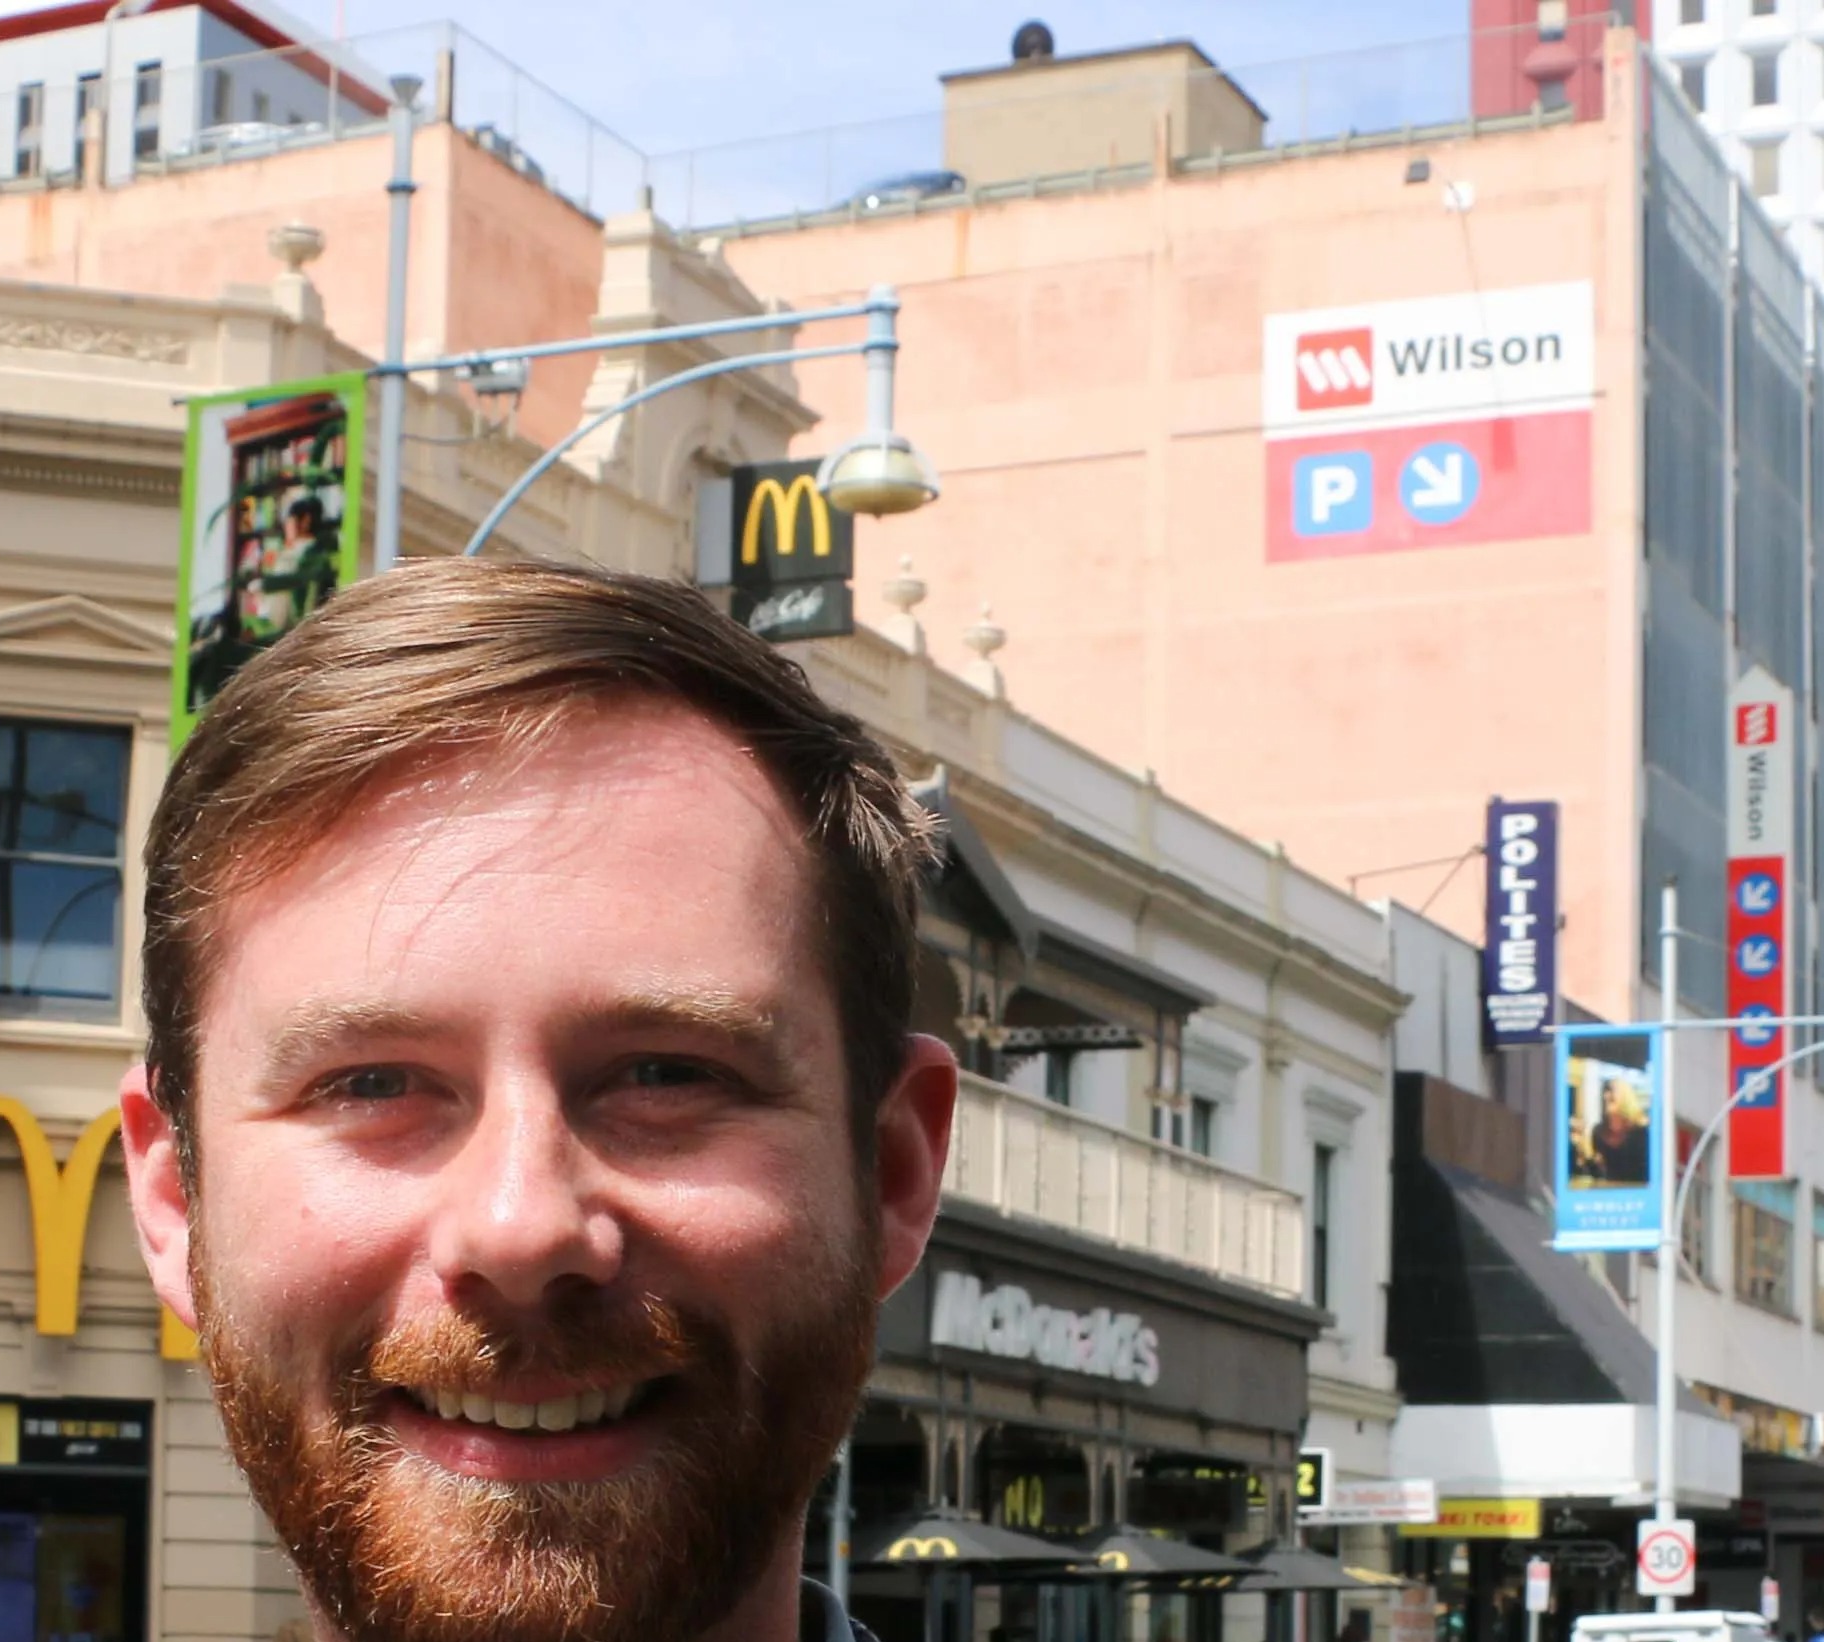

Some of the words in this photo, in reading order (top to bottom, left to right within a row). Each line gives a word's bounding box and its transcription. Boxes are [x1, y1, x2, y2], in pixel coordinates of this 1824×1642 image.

[1388, 331, 1562, 378] Wilson
[1311, 465, 1358, 524] P
[1746, 750, 1768, 842] Wilson
[1499, 812, 1538, 993] POLITES
[1650, 1545, 1684, 1569] 30
